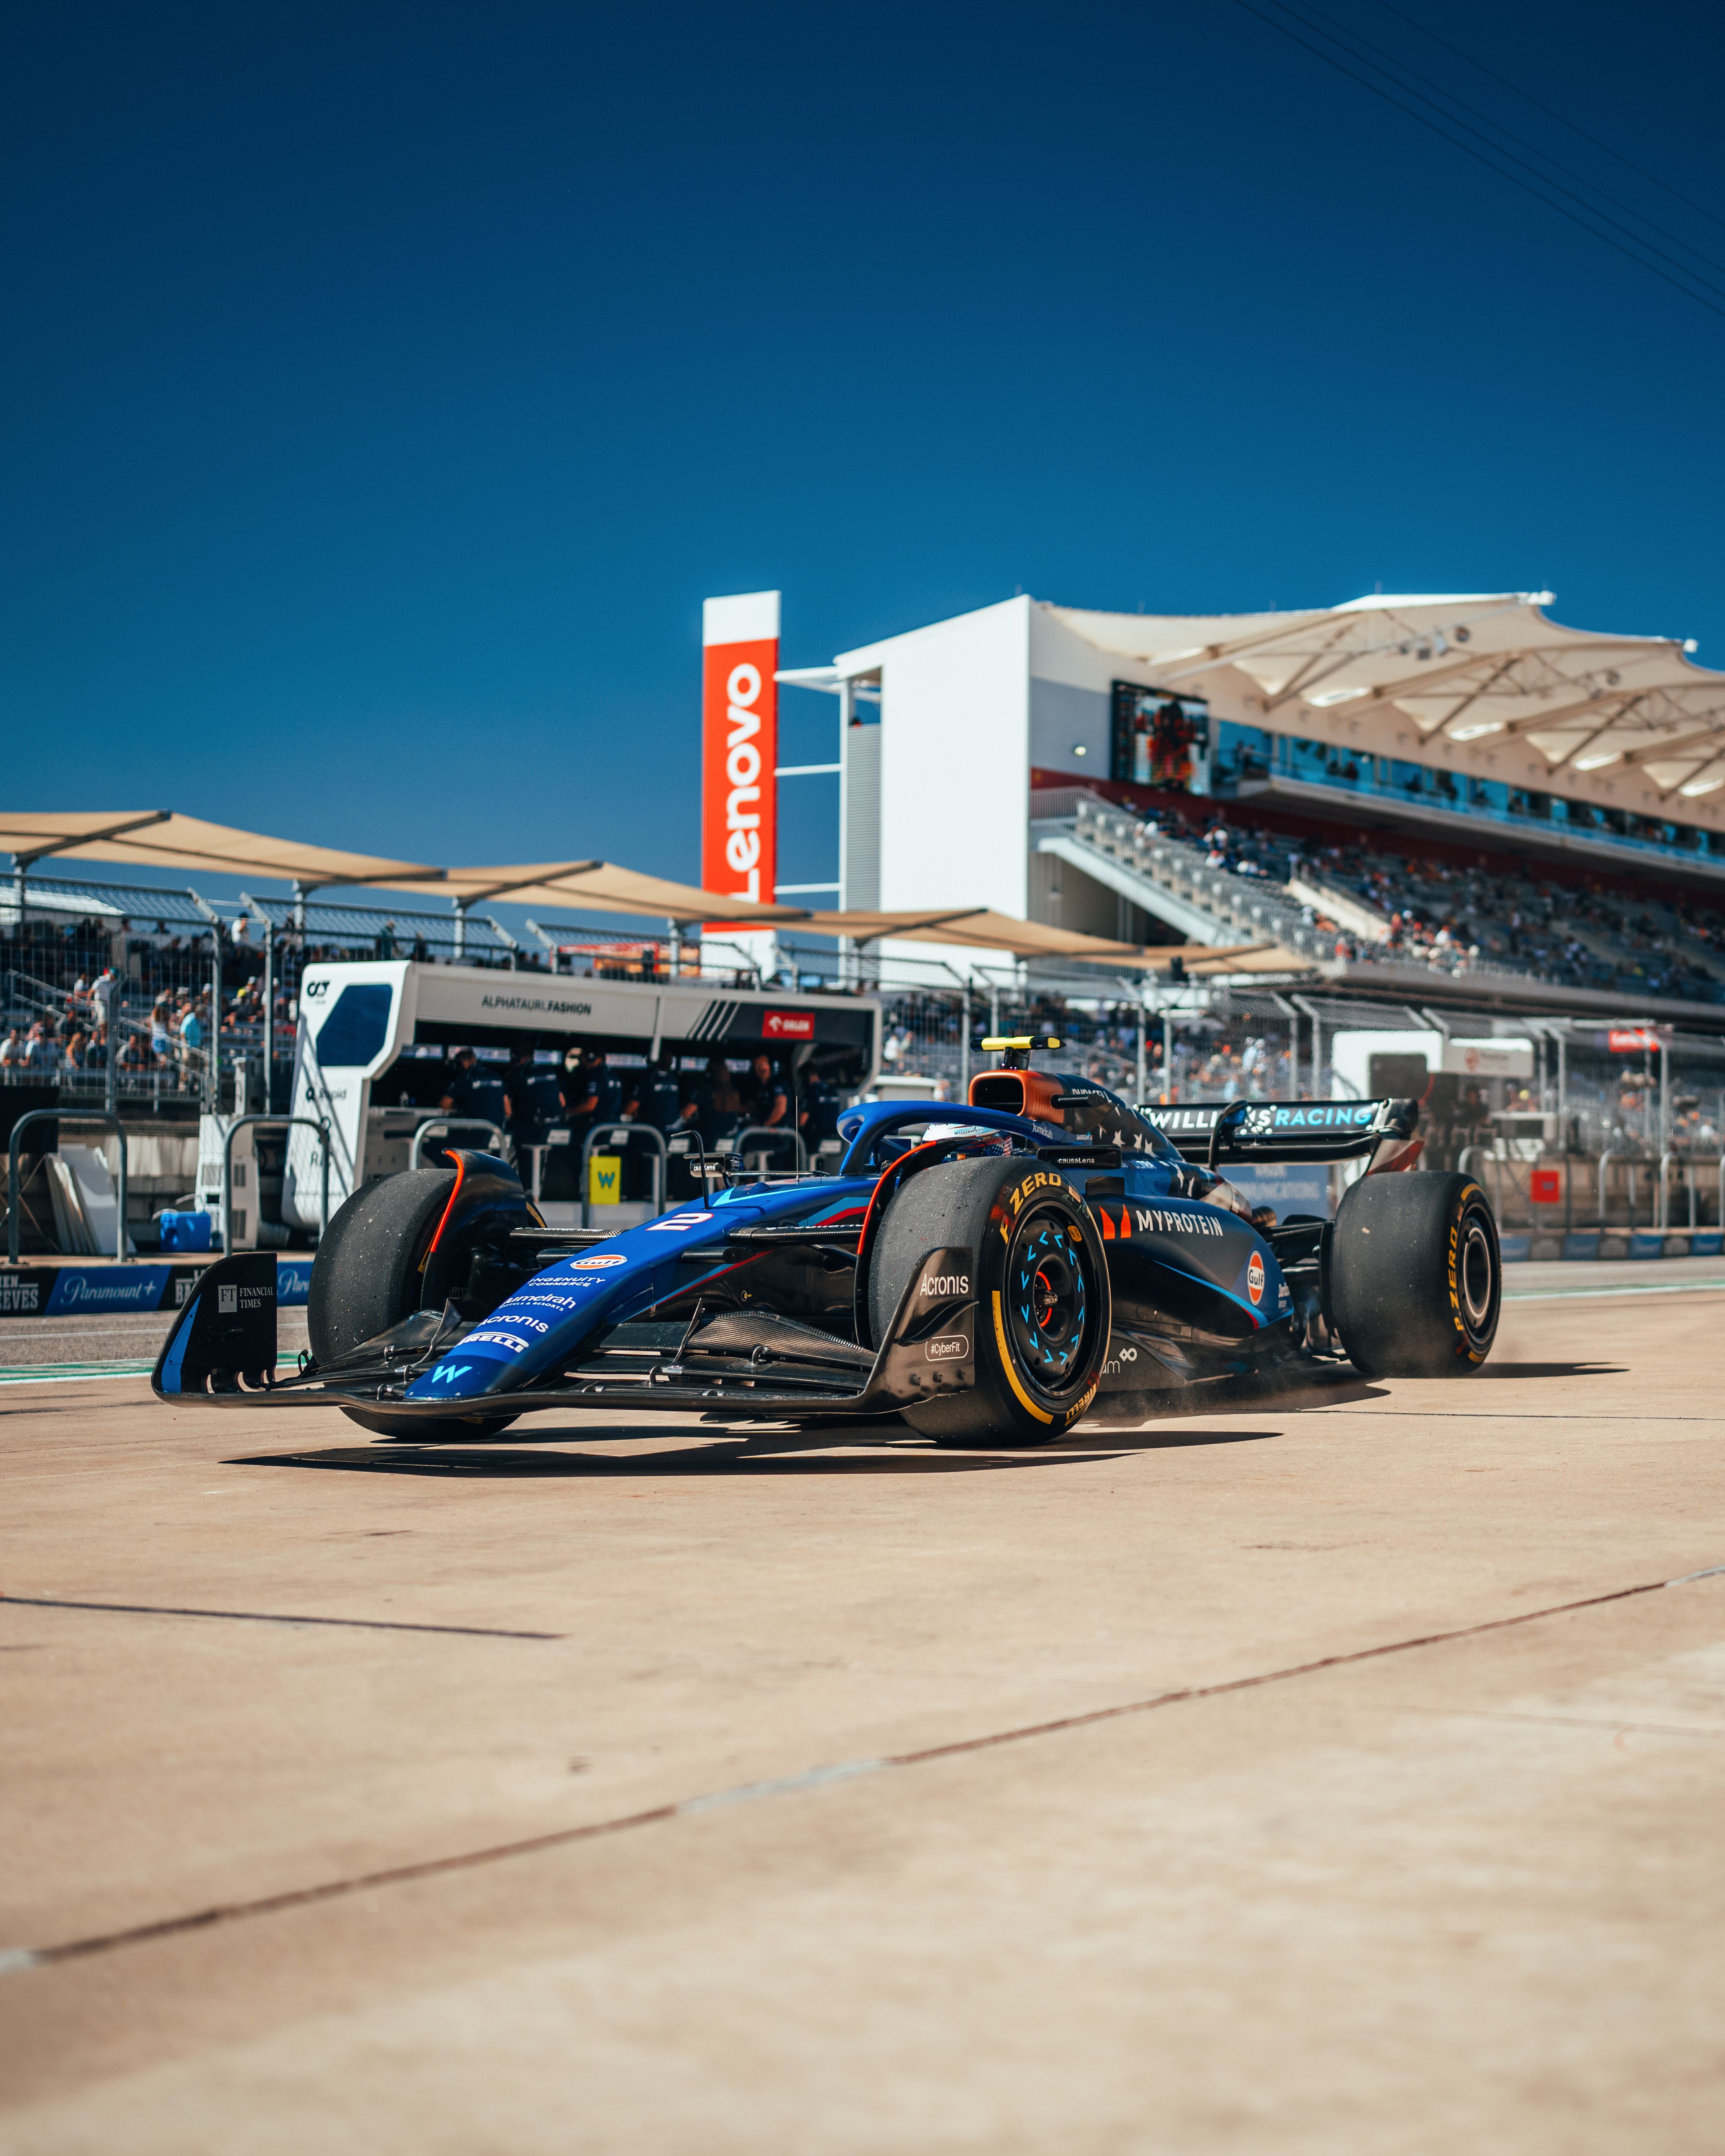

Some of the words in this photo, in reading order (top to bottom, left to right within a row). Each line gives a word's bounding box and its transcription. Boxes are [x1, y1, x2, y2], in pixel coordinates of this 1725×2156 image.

[726, 662, 762, 904] Lenovo
[482, 994, 591, 1014] ALPHATAURI.FASHION
[1149, 1109, 1271, 1128] WILLIS
[1274, 1108, 1372, 1127] RACING
[598, 1171, 615, 1188] W
[1009, 1172, 1061, 1215] ZERO
[645, 1213, 715, 1231] 2
[1135, 1210, 1223, 1236] MYPROTEIN
[1448, 1226, 1458, 1309] ZERO
[920, 1273, 969, 1296] Acronis
[1249, 1268, 1264, 1287] Gulf
[0, 1290, 39, 1310] EVES
[220, 1288, 235, 1302] FT
[239, 1287, 274, 1297] FINANCIAL
[239, 1299, 261, 1308] TIMES
[532, 1302, 564, 1312] RESORTS
[931, 1341, 961, 1356] #CyberFit
[431, 1364, 473, 1383] W
